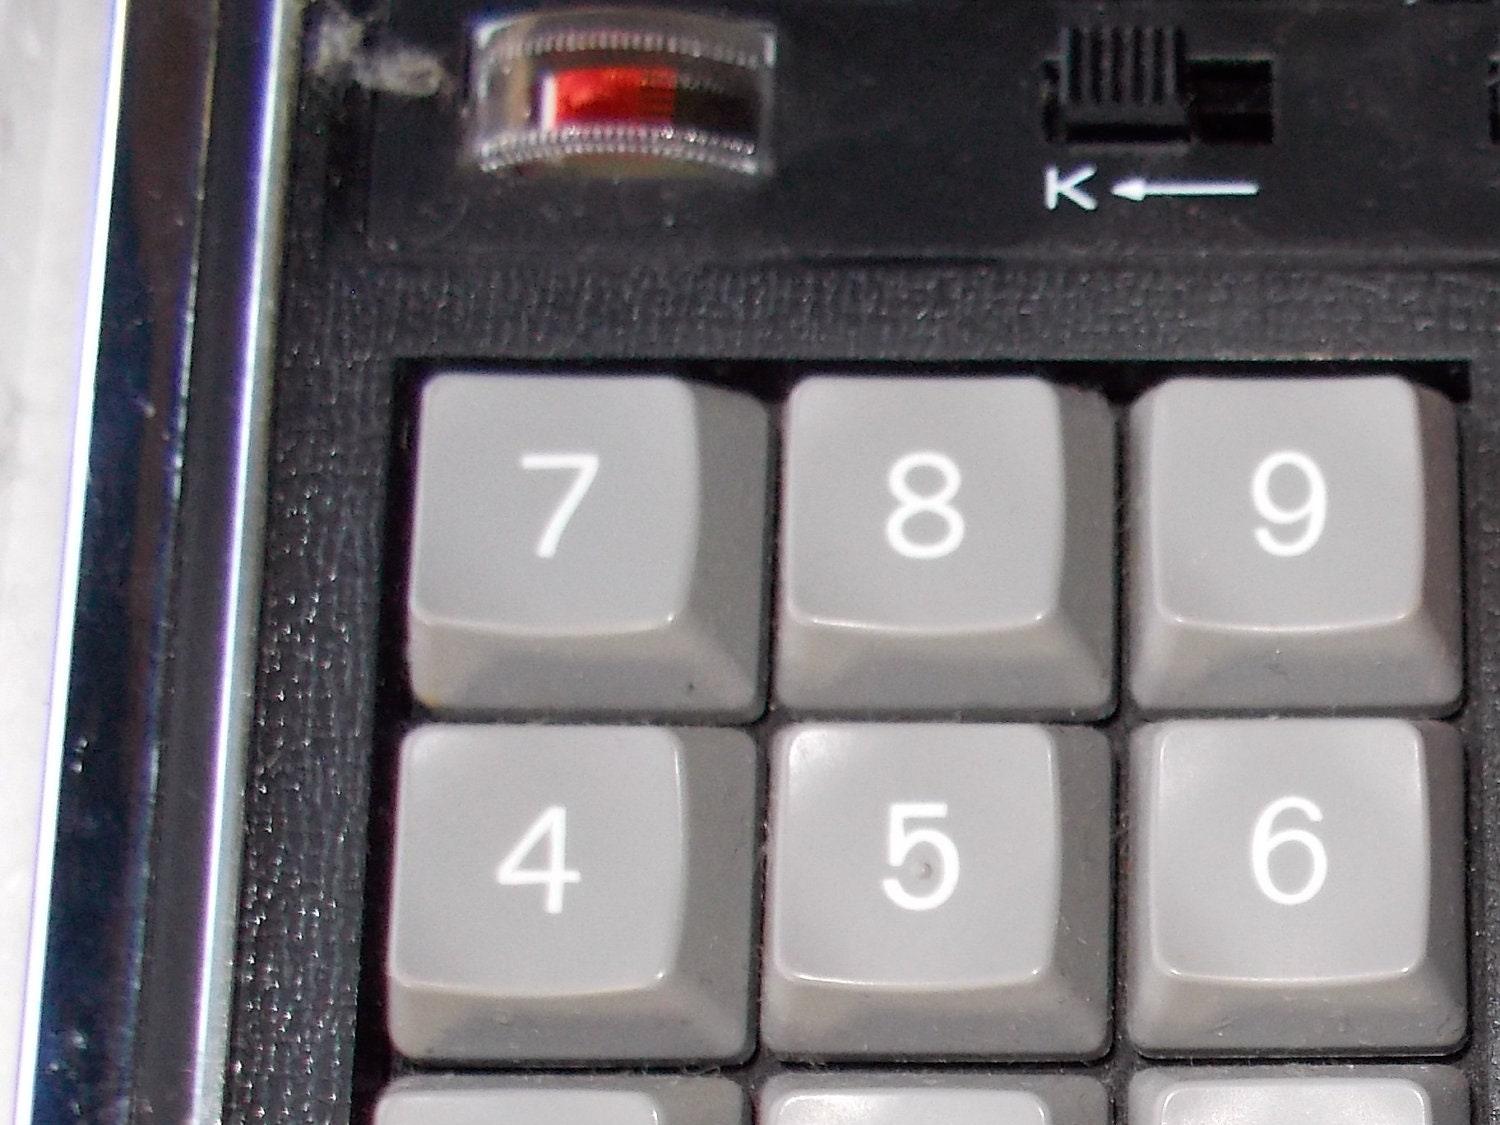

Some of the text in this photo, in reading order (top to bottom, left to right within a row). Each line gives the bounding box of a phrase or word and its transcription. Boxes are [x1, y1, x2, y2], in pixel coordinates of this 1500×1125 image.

[1045, 167, 1096, 211] K
[520, 452, 600, 559] 7
[884, 450, 966, 560] 8
[1250, 449, 1328, 558] 9
[496, 805, 582, 915] 4
[881, 801, 961, 912] 5
[1249, 795, 1329, 907] 6
